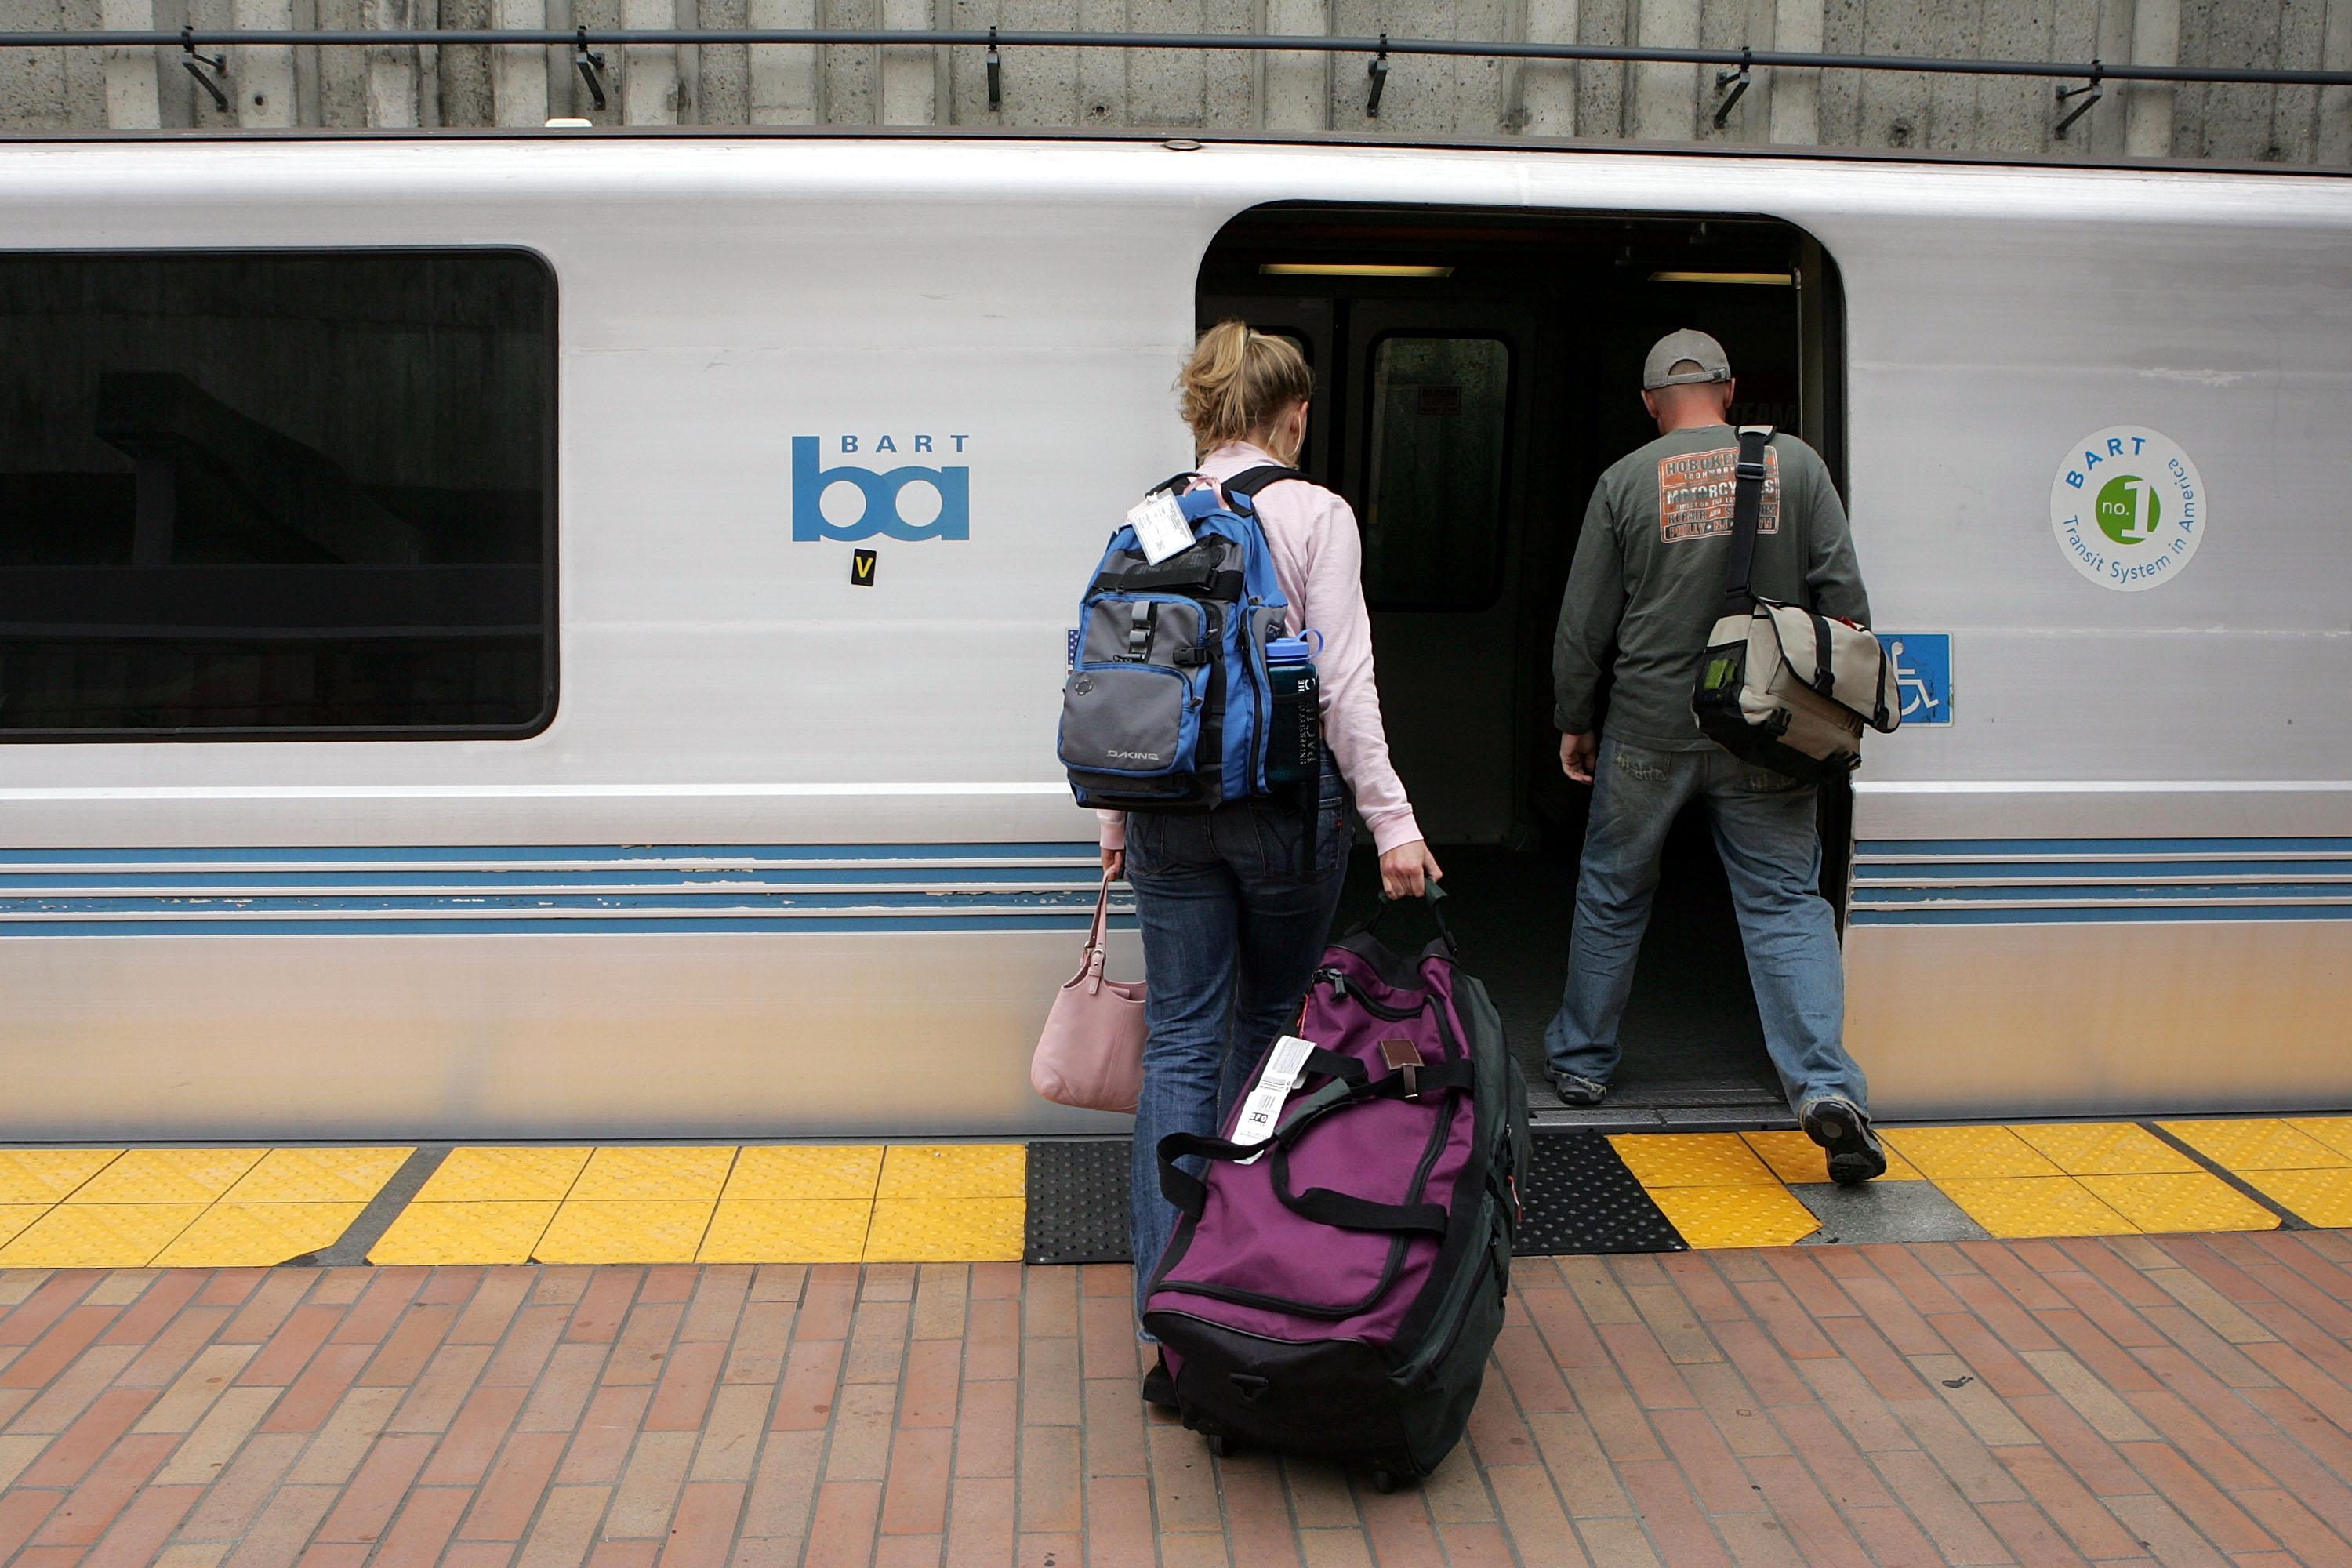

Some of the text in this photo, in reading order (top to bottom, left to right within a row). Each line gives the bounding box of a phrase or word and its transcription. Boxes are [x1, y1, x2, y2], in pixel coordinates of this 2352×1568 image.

[842, 435, 969, 452] BART
[1684, 466, 1736, 480] IRONWORK
[2065, 436, 2146, 489] BART
[2063, 458, 2194, 583] Transit System in America
[2102, 481, 2151, 539] no. 1
[856, 556, 873, 578] V
[1106, 750, 1160, 760] DAKINE
